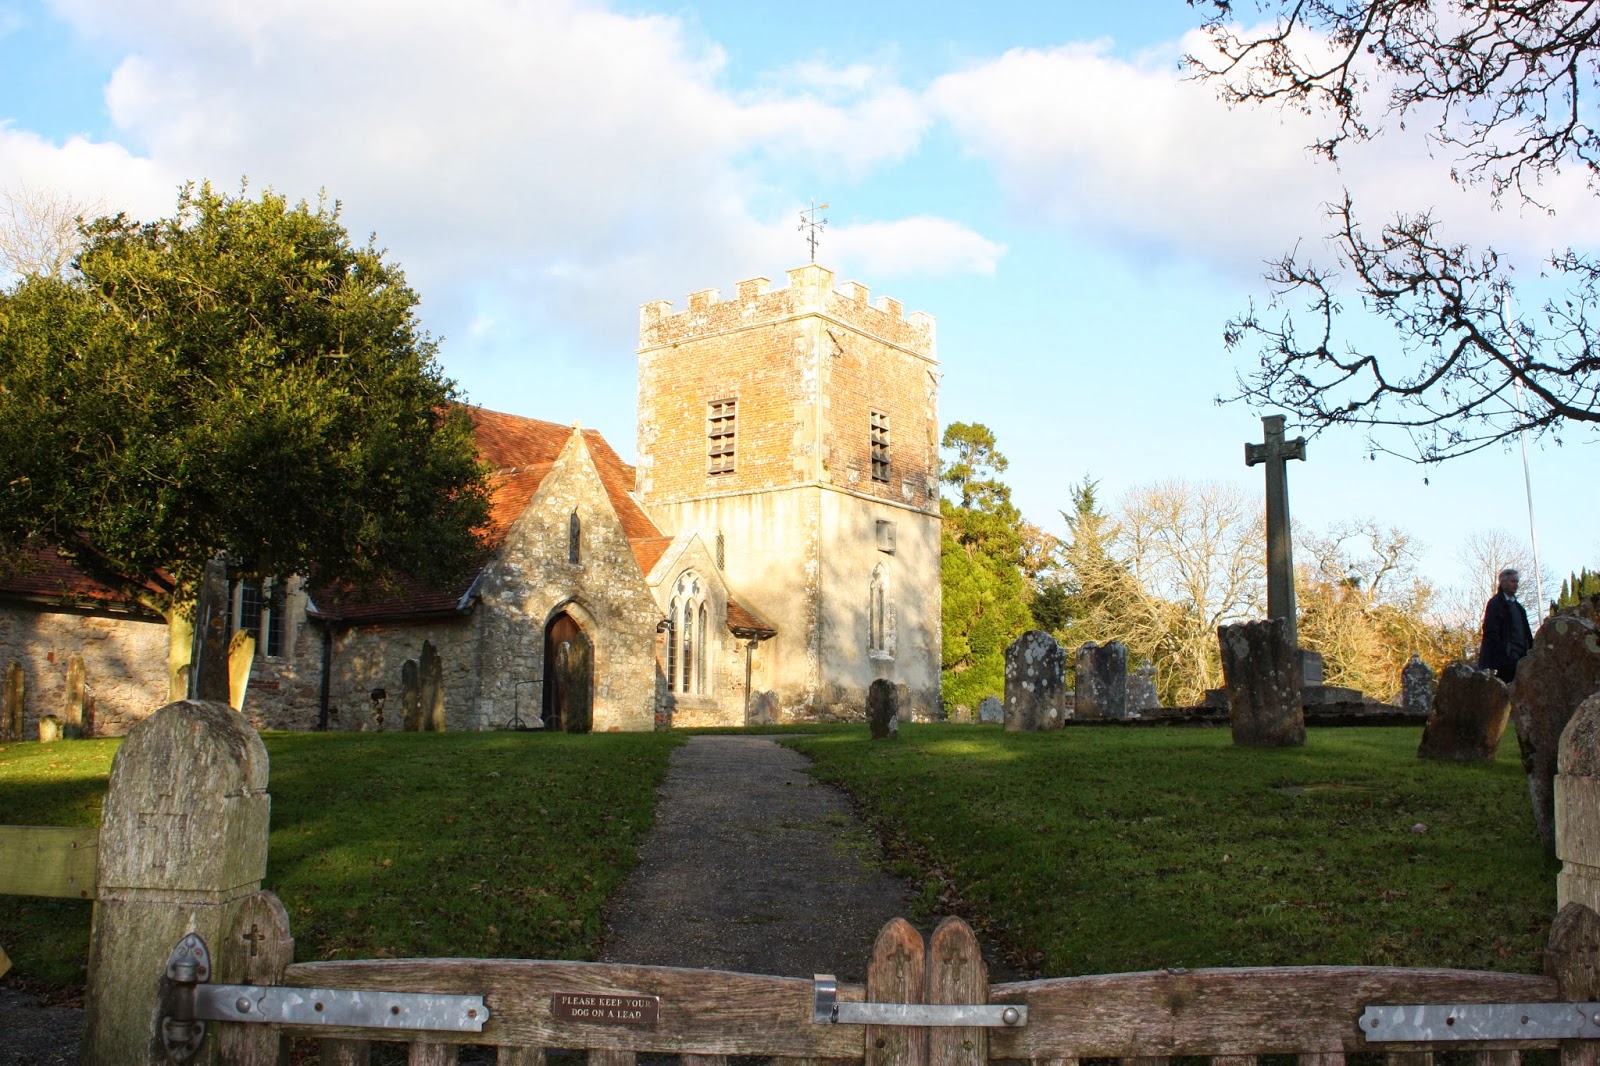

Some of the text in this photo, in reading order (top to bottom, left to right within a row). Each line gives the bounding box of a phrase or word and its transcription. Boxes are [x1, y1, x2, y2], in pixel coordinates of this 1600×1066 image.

[562, 997, 651, 1008] PLEASE KEEP YOUR
[572, 1008, 589, 1016] DOG
[592, 1009, 604, 1017] ON
[607, 1010, 614, 1018] A
